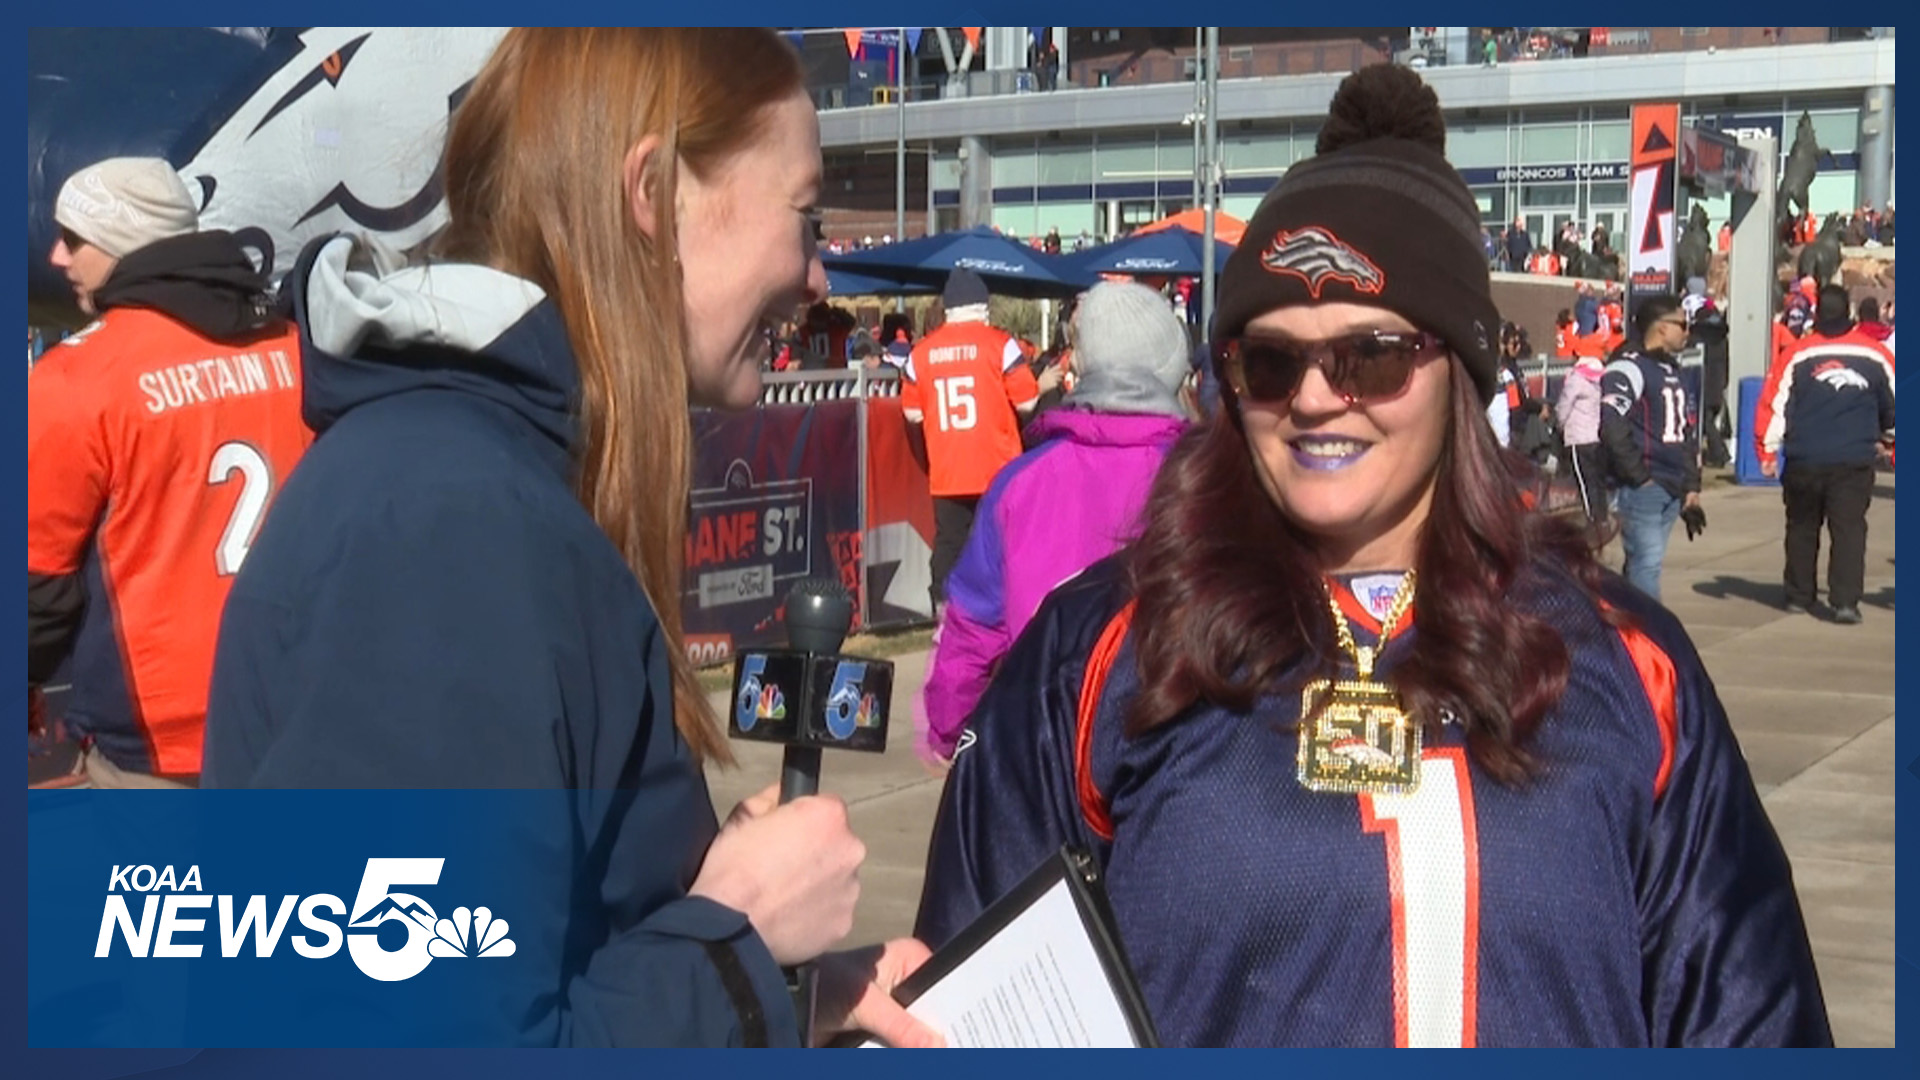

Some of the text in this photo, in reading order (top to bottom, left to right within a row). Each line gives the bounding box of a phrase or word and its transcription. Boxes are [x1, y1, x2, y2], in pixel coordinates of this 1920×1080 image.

[1496, 167, 1566, 181] BRONCOS
[1571, 164, 1614, 178] TEAM
[139, 353, 269, 414] SURTAIN
[928, 344, 978, 365] BONITTO
[933, 375, 978, 432] 15
[1661, 386, 1686, 443] 11
[208, 440, 271, 577] 2
[763, 507, 804, 556] ST.
[736, 654, 768, 732] 5
[825, 661, 868, 740] 5
[1358, 746, 1480, 1048] 1
